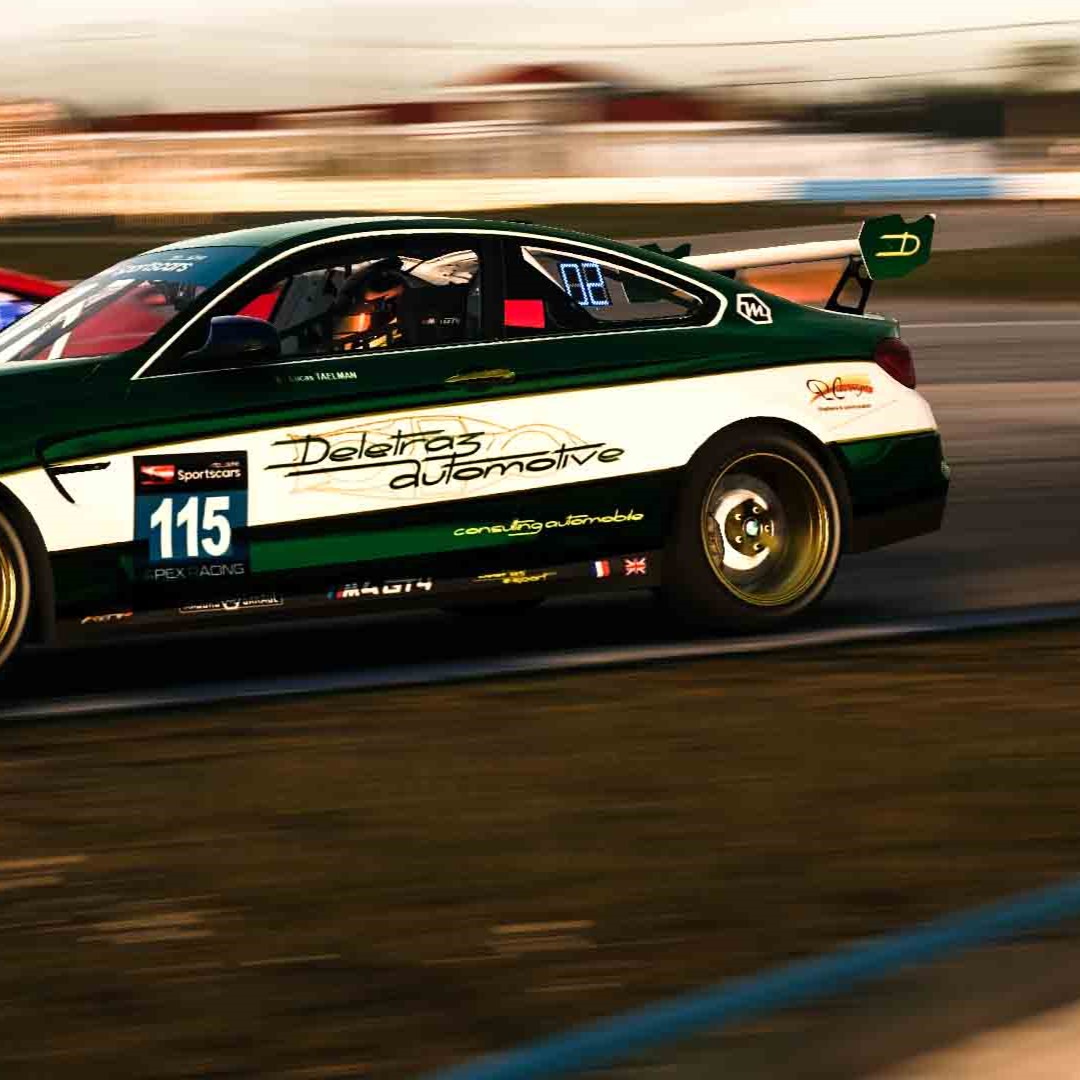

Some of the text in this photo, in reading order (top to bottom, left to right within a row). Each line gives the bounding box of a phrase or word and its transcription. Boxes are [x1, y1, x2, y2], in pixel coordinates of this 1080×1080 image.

[316, 371, 357, 381] TAELMAN
[284, 443, 625, 489] automotive
[177, 468, 241, 483] Sportscars
[545, 509, 644, 527] automobile
[150, 496, 231, 559] 115
